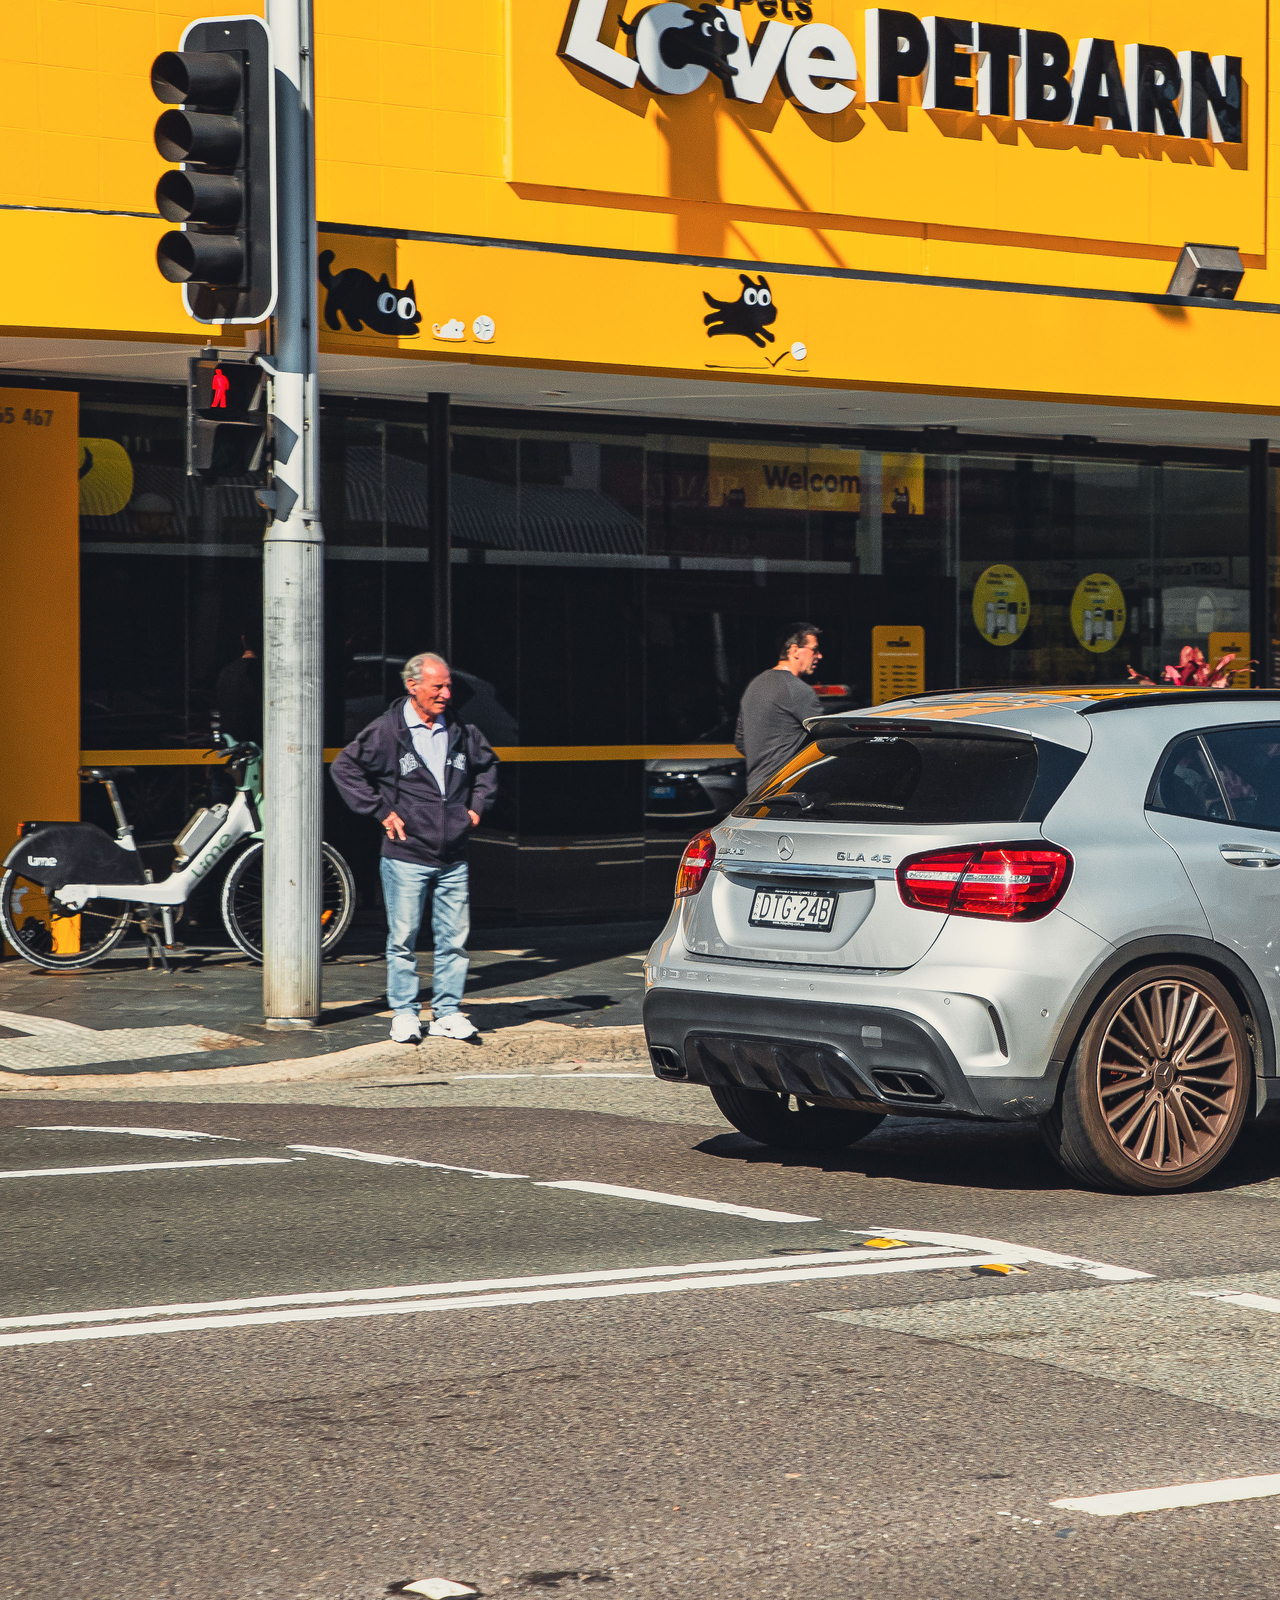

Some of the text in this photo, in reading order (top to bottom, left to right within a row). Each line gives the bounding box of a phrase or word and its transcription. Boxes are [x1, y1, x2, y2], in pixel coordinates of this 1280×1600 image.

[865, 8, 1243, 143] PETBARN
[23, 408, 54, 427] 467
[27, 855, 58, 867] Lime
[191, 833, 232, 879] Lime
[836, 851, 892, 864] GLA 45
